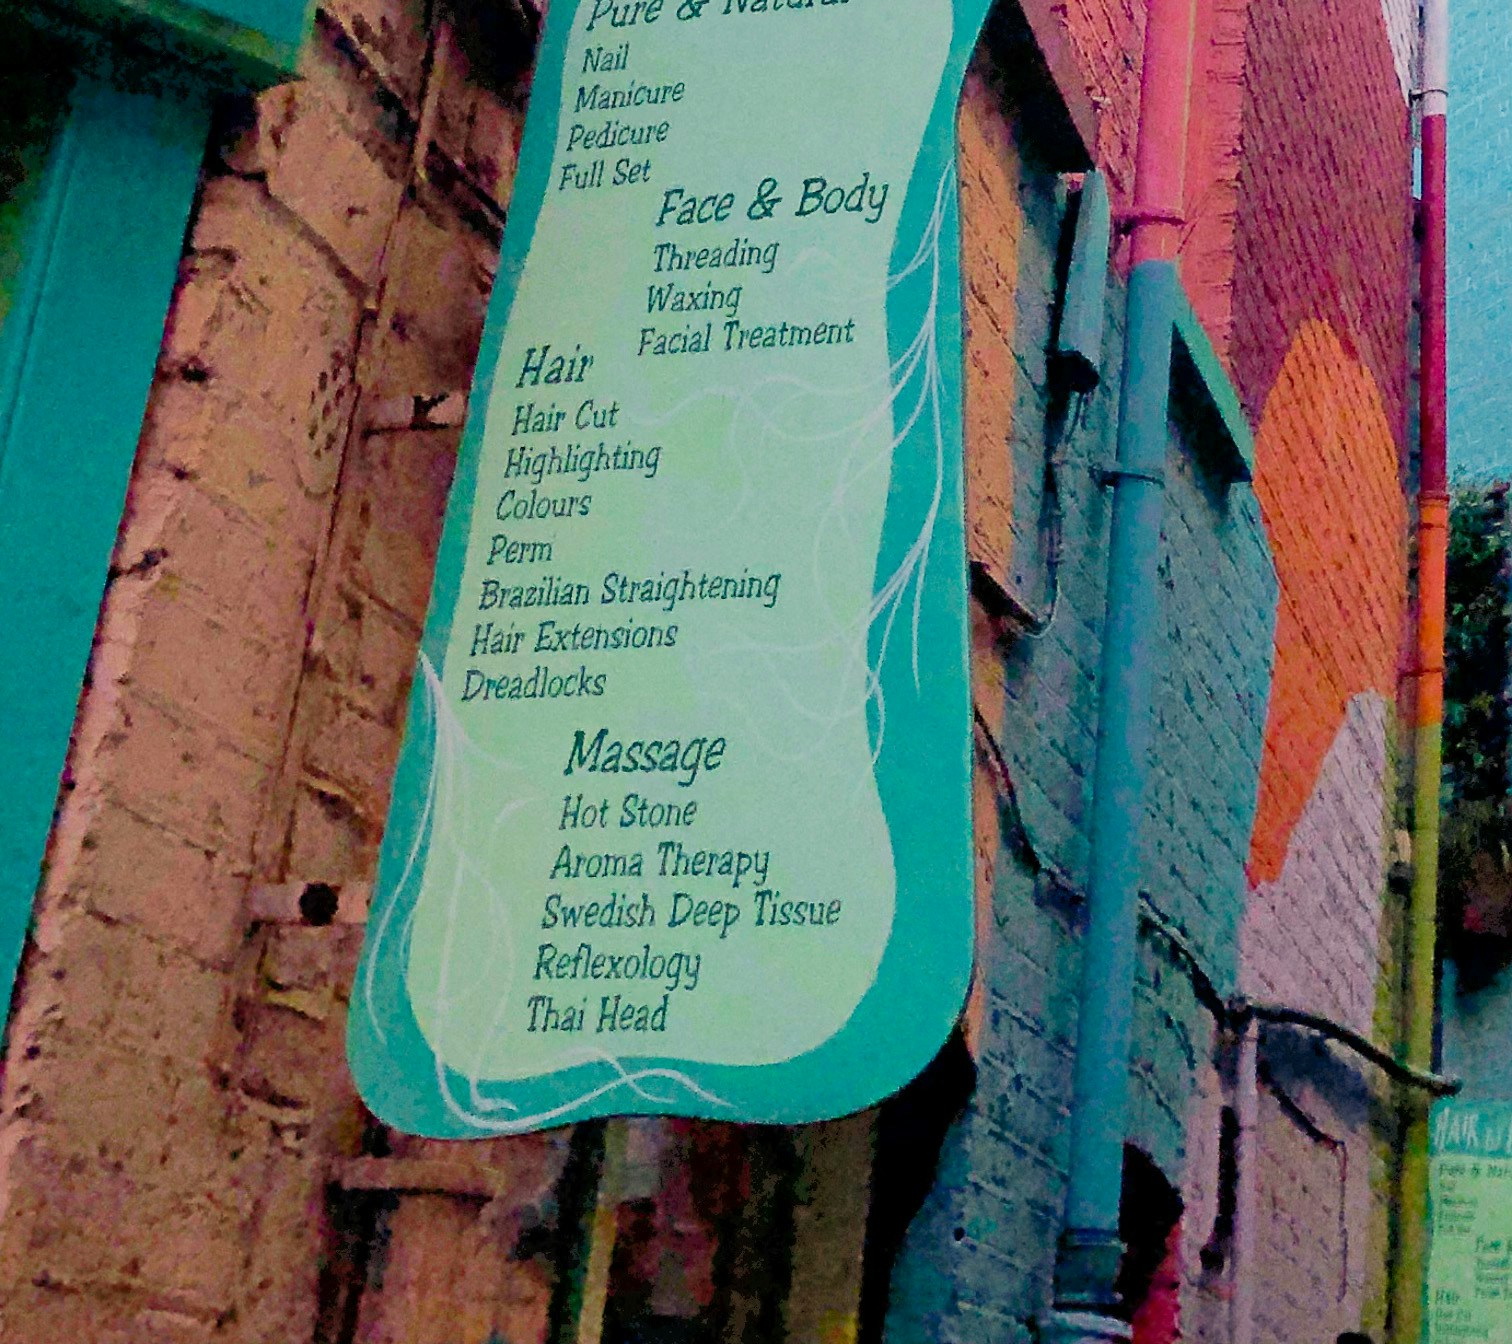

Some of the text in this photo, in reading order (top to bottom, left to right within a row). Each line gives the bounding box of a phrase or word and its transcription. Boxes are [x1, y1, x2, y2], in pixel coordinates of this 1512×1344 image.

[581, 42, 630, 74] Nail
[574, 80, 685, 113] Manicure
[565, 120, 670, 152] Pedicure
[558, 157, 652, 192] Full Set
[655, 171, 889, 227] Face & Body
[653, 237, 780, 274] Threading
[647, 281, 743, 319] Waxing
[637, 318, 856, 357] Facial Treatment
[514, 344, 594, 389] Hair
[511, 399, 619, 437] Hair Cut
[503, 442, 662, 485] Highlighting
[496, 488, 592, 522] Colours
[486, 533, 553, 566] Perm
[478, 569, 782, 612] Brazilian Straightening
[469, 620, 679, 658] Hair Extensions
[460, 665, 607, 703] Dreadlocks
[563, 728, 727, 788] Massage
[558, 792, 698, 831] Hot Stone
[549, 840, 770, 889] Aroma Therapy
[541, 890, 841, 940] Swedish Deep Tissue
[532, 942, 701, 992] Reflexology
[527, 993, 670, 1034] Thai Head
[1434, 1107, 1479, 1152] HAIR
